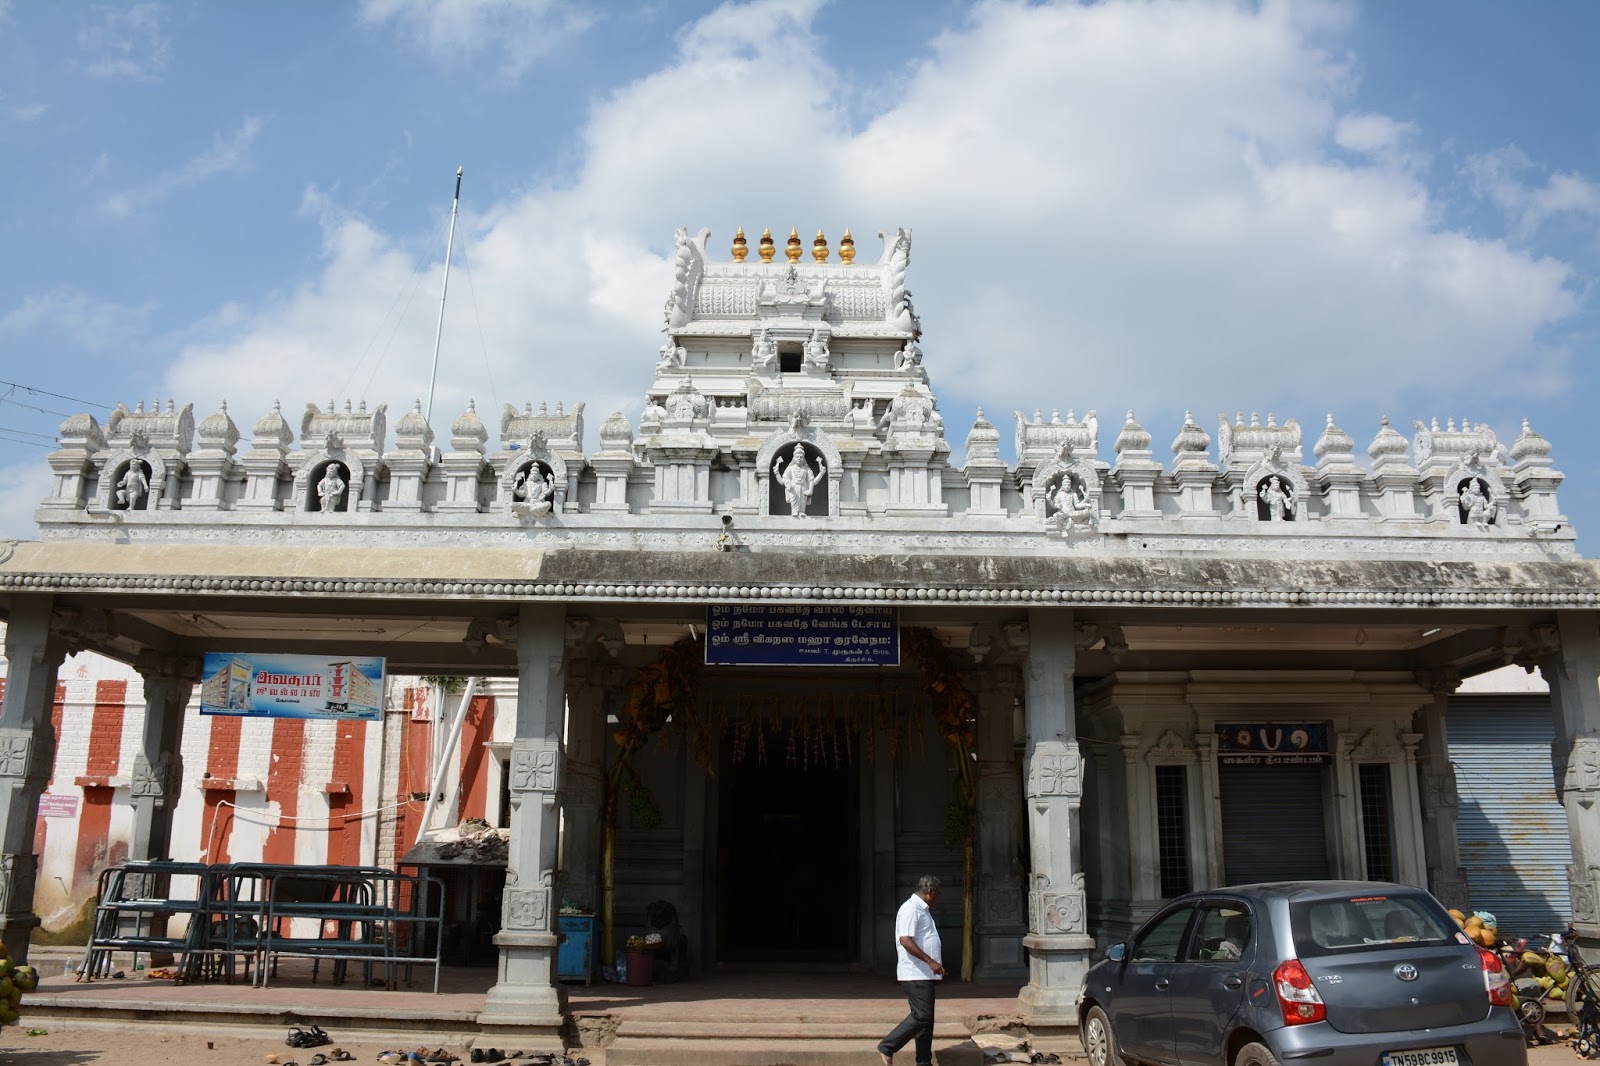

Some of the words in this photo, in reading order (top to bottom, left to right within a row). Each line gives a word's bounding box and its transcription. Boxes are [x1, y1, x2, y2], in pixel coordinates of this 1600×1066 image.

[712, 617, 729, 630] ஓம்
[732, 618, 764, 630] நமோ
[711, 632, 730, 646] ஓம்
